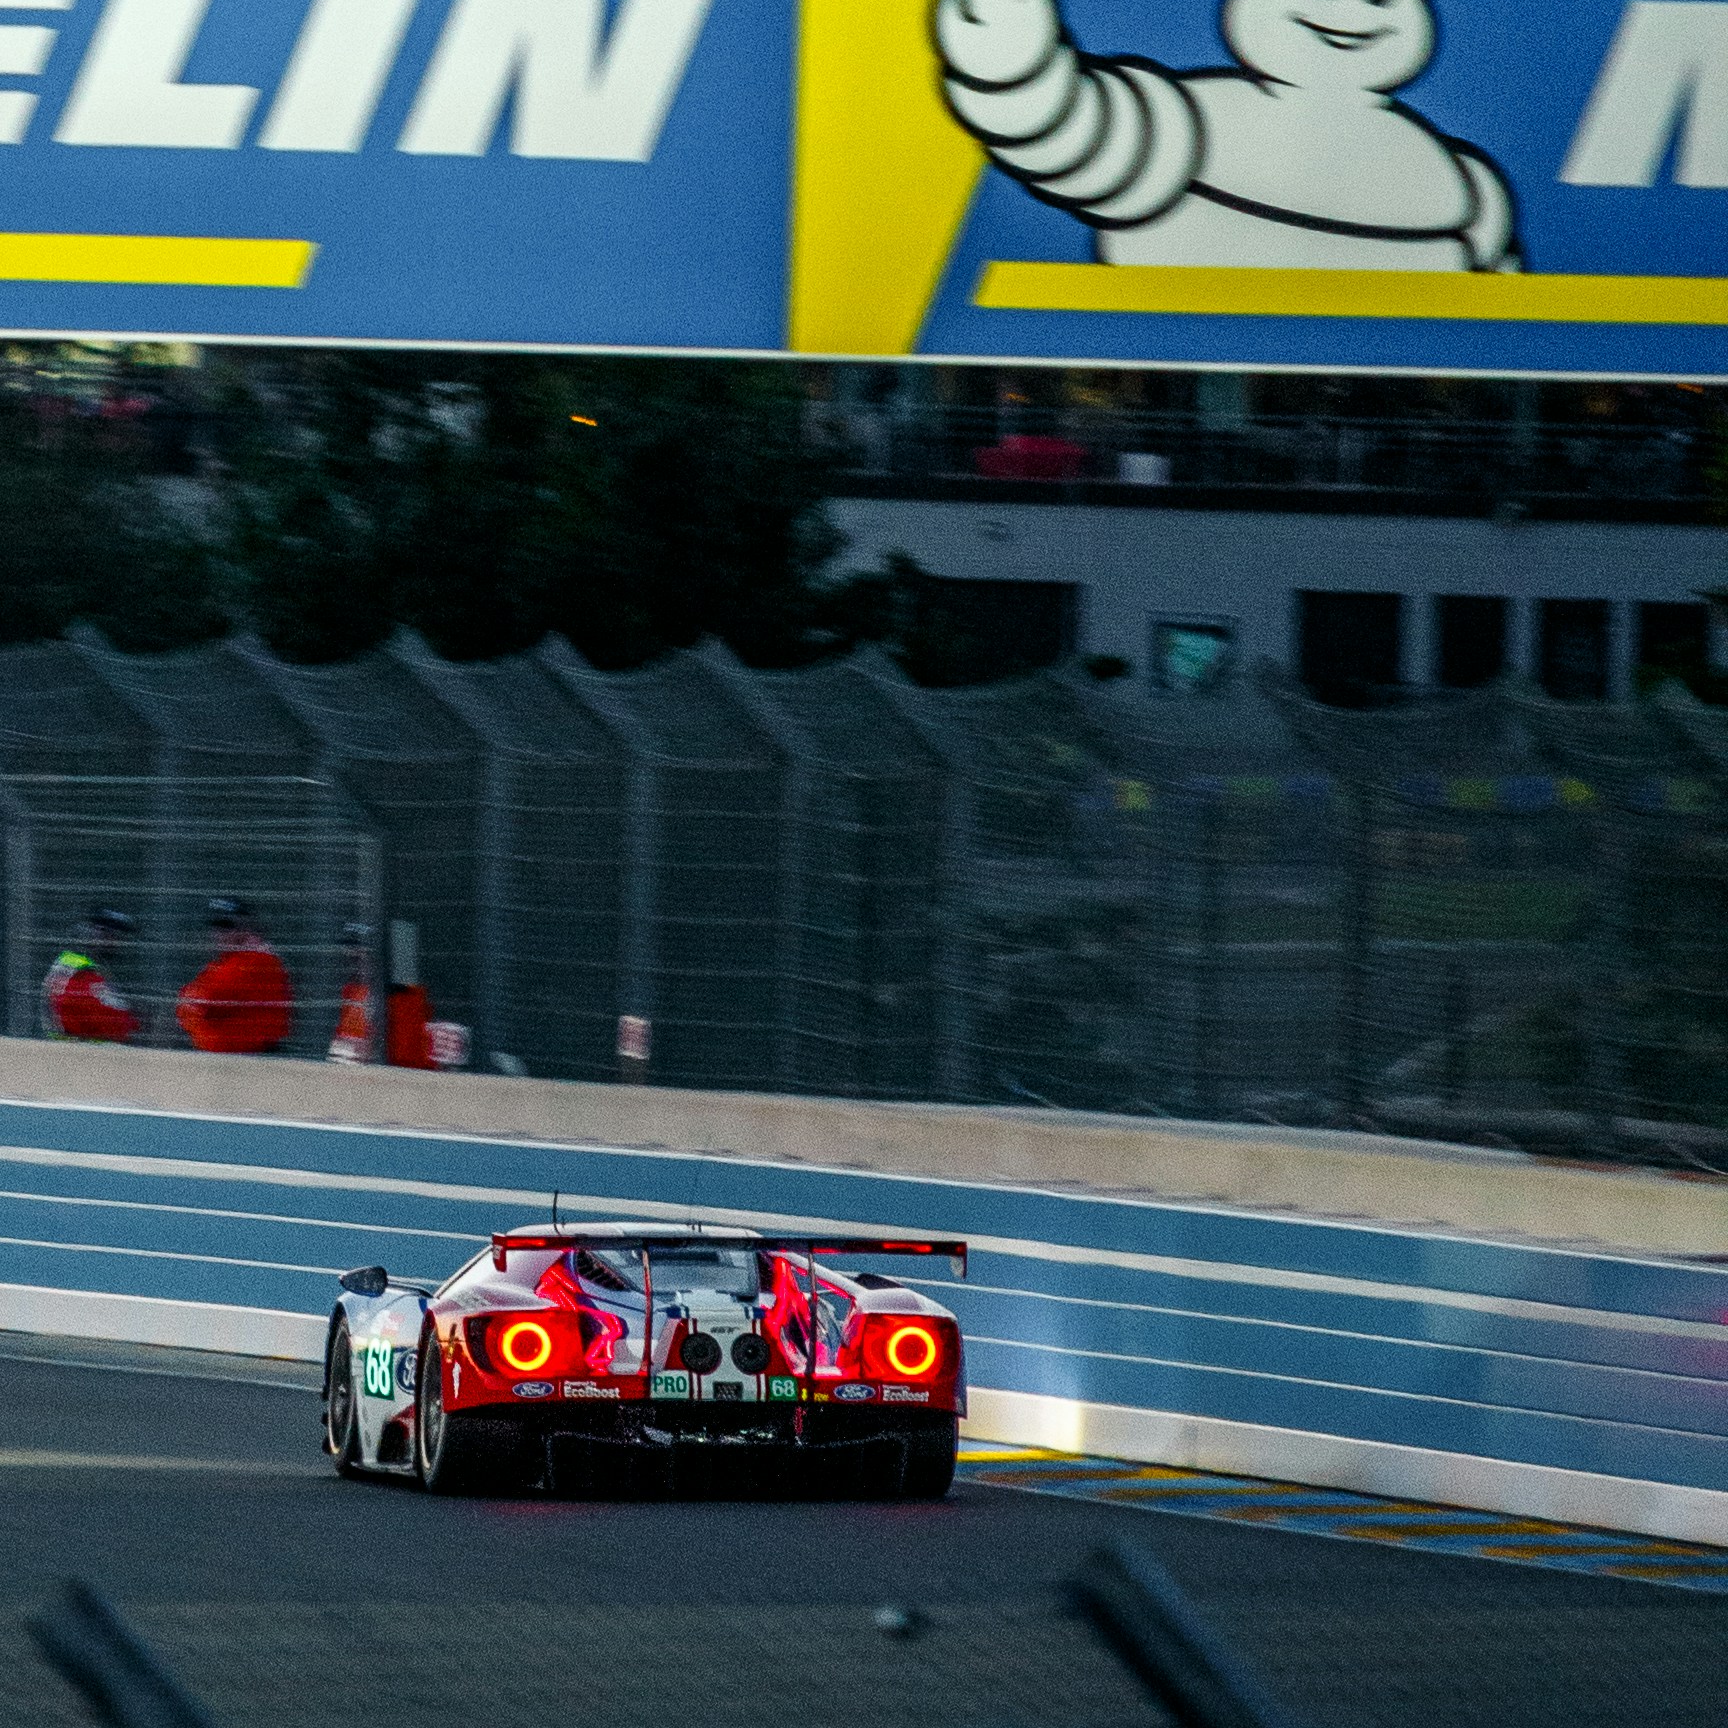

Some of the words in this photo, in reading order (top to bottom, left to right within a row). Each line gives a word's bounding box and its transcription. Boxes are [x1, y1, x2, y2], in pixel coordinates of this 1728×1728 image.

[365, 1338, 391, 1396] 68
[564, 1386, 620, 1398] EcoBoost
[653, 1375, 688, 1393] PRO
[772, 1379, 796, 1397] 68
